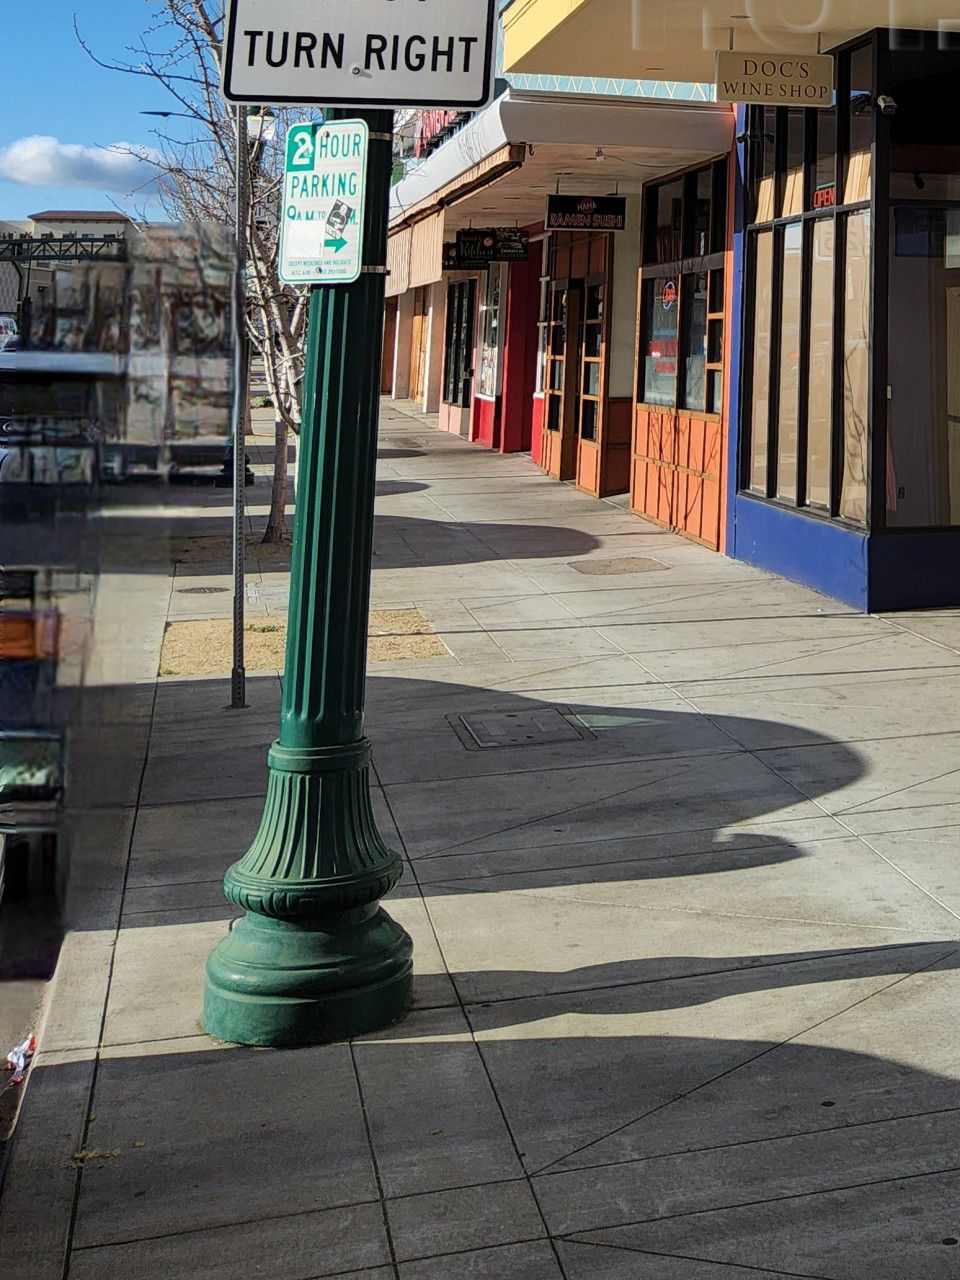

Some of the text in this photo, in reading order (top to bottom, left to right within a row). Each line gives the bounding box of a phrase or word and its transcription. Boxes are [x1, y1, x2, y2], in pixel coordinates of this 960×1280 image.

[244, 30, 477, 73] TURN RIGHT
[743, 59, 809, 79] DOC'S
[723, 81, 828, 99] WINE SHOP
[292, 131, 361, 165] 2 HOUR
[291, 172, 357, 198] PARKING
[813, 187, 835, 209] OPEN
[550, 212, 623, 227] RAMEN SUSHI
